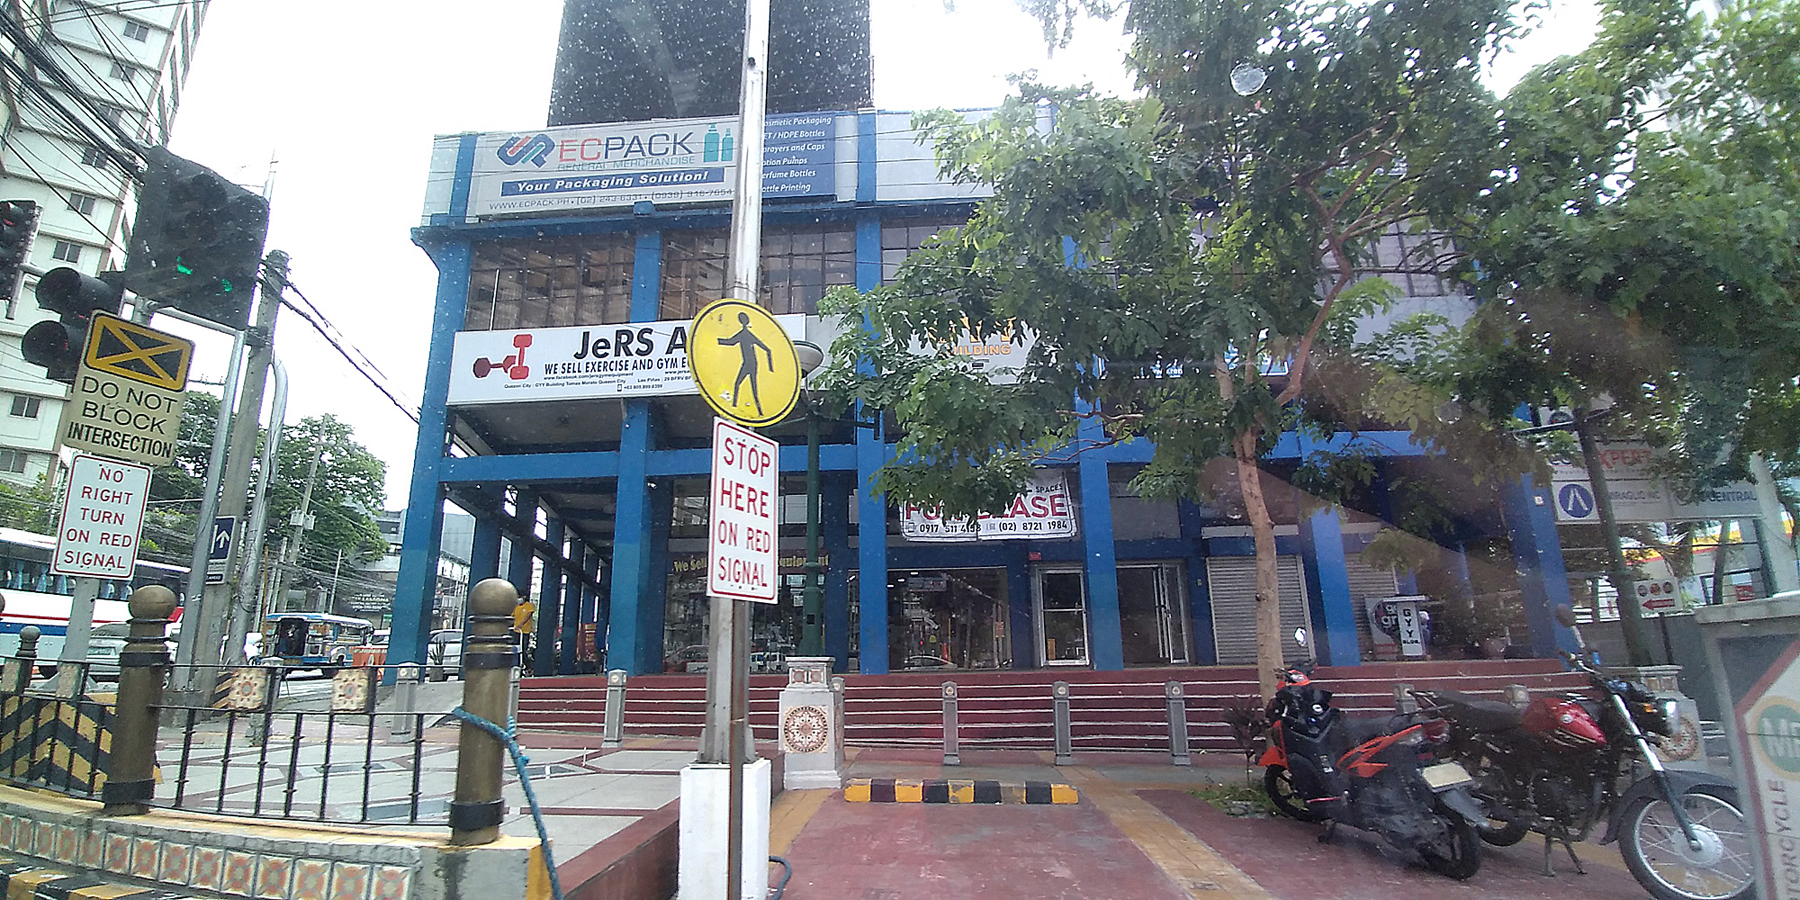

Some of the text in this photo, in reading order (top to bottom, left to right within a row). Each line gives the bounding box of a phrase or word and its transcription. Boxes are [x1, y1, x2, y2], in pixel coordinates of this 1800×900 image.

[763, 117, 832, 126] osmetic Packaging
[800, 129, 826, 137] Bottles
[558, 131, 695, 162] ECPACK
[763, 143, 825, 154] prayers and Caps
[557, 155, 696, 172] GENERAL MERCHANDISE
[762, 157, 807, 166] otion Pumps
[516, 170, 709, 192] Your Packaging Solution!
[762, 169, 816, 179] erfume Bottles
[762, 183, 811, 193] ottle Printing
[577, 195, 596, 206] (02)
[573, 328, 654, 360] JeRS
[544, 363, 558, 375] WE
[560, 362, 584, 374] SELL
[585, 360, 629, 373] EXERCISE
[631, 359, 653, 371] AND
[656, 357, 678, 369] GYM
[81, 376, 178, 413] DO NOT
[82, 400, 168, 435] BLOCK
[67, 421, 173, 459] INTERSECTION
[723, 437, 770, 477] STOP
[1598, 450, 1650, 468] XPERT
[99, 468, 124, 483] NO
[81, 486, 133, 505] RIGHT
[1035, 483, 1063, 493] SPACES
[720, 478, 769, 519] HERE
[977, 493, 1068, 518] ASE
[80, 508, 125, 526] TURN
[920, 524, 939, 533] 0917
[999, 521, 1017, 532] (02)
[1022, 521, 1043, 531] 8721
[1047, 520, 1068, 530] 1984
[66, 528, 132, 548] ON RED
[718, 520, 771, 553] ON RED
[64, 550, 126, 569] SIGNAL
[673, 561, 689, 572] We
[690, 557, 708, 571] Sell
[718, 556, 768, 587] SIGNAL
